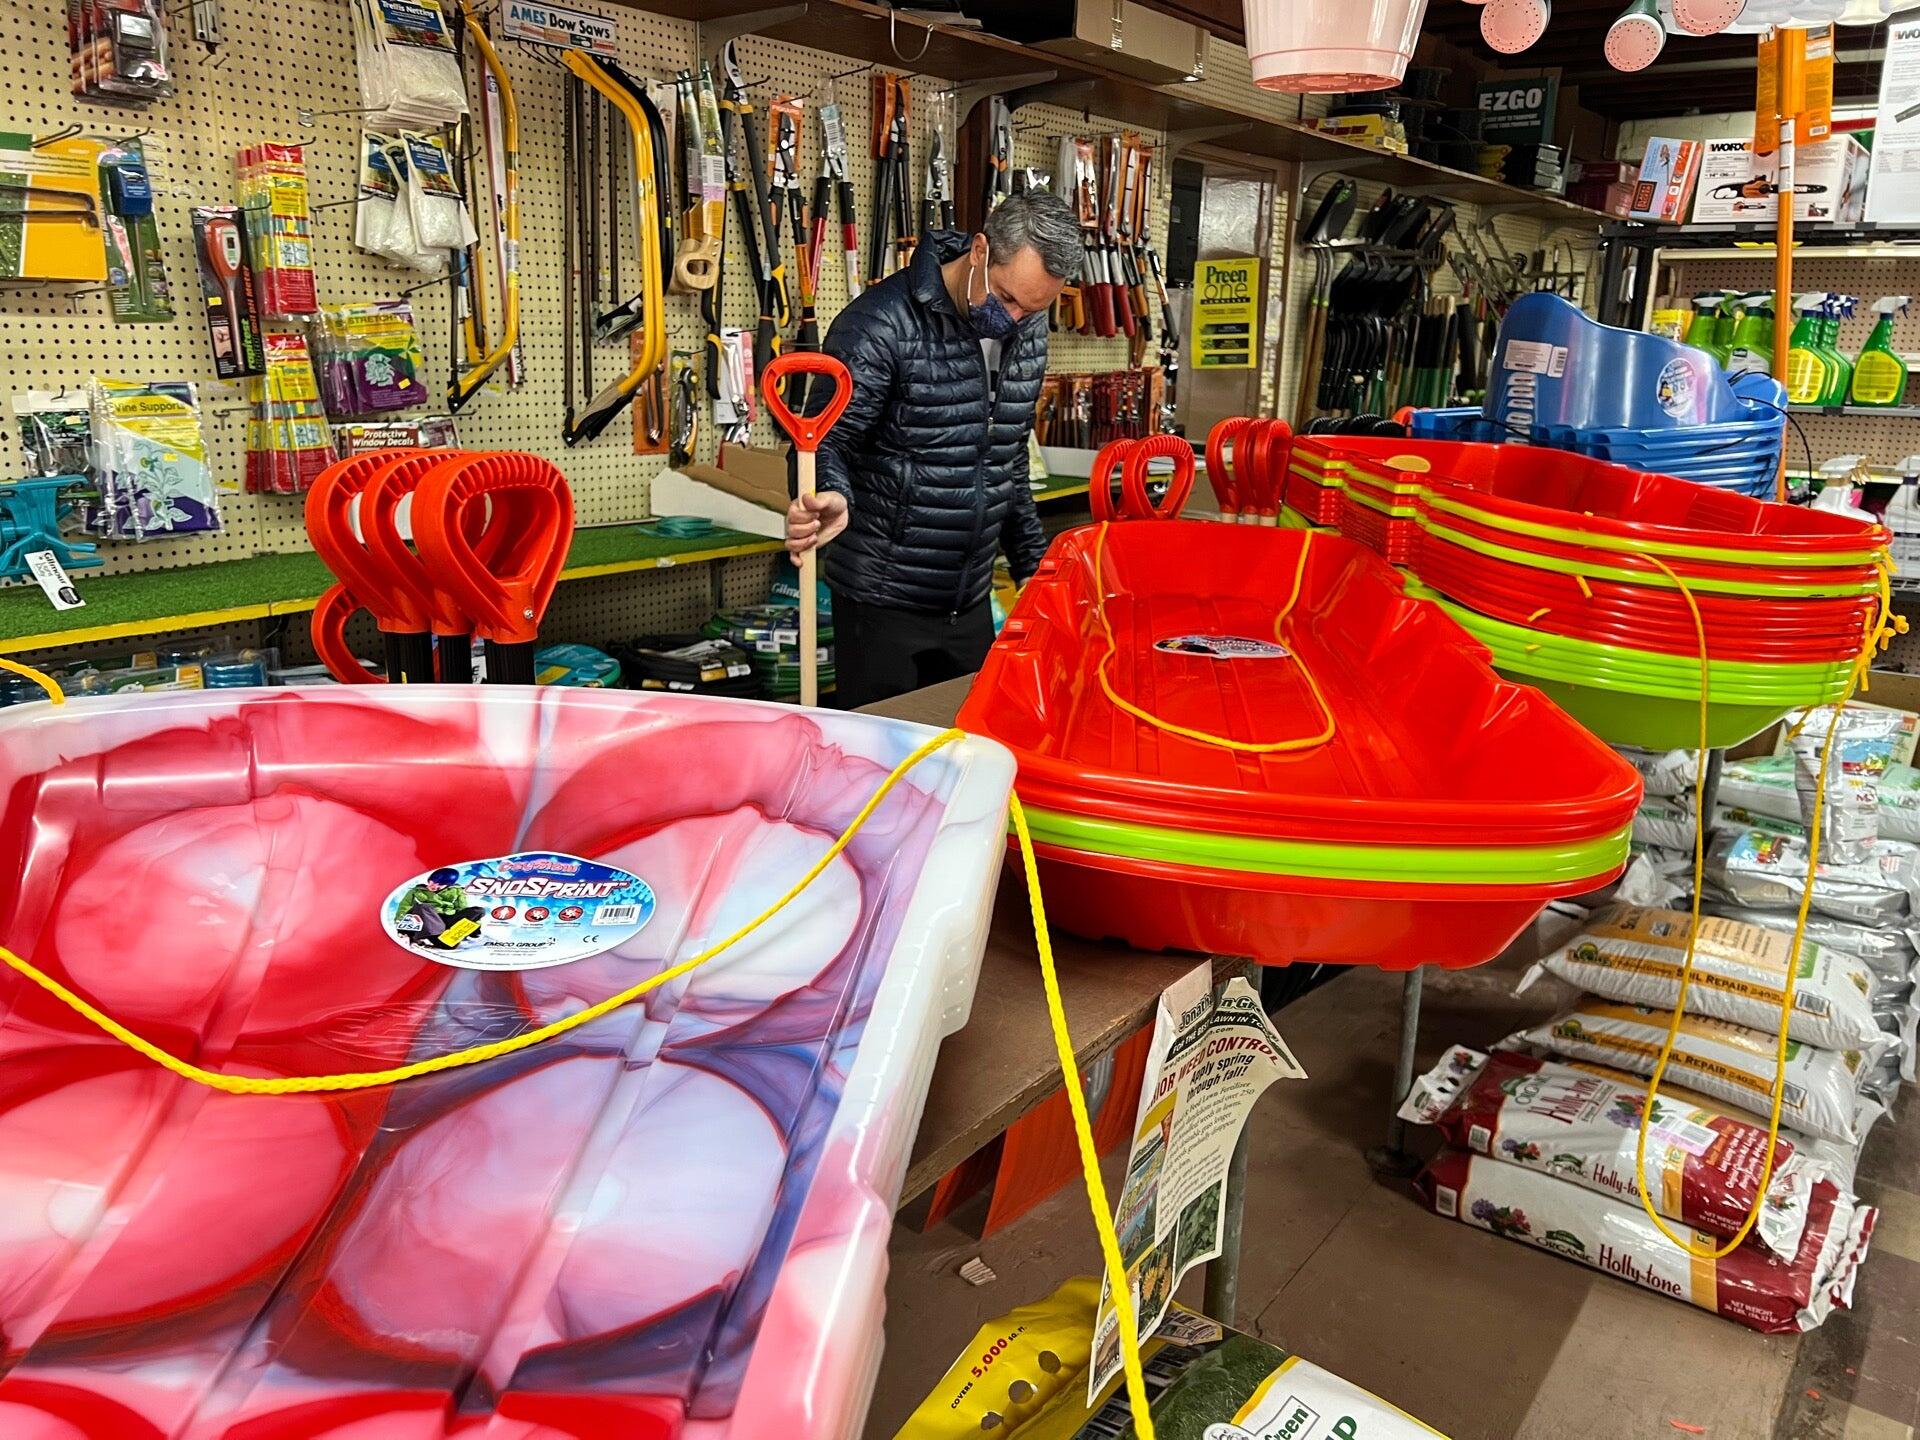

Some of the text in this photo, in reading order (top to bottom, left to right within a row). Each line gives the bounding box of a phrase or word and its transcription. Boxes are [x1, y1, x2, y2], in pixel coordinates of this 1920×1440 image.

[509, 5, 547, 26] AMES
[579, 20, 611, 39] Saws
[1897, 28, 1920, 40] WO
[1478, 87, 1543, 111] EZGO
[1710, 142, 1746, 152] WORX
[1205, 266, 1248, 284] Preen
[1203, 282, 1248, 300] one
[114, 403, 138, 412] Vine
[352, 437, 414, 447] Window Decals
[363, 429, 408, 439] Protective
[44, 552, 67, 584] Gilmour
[771, 582, 800, 599] Gilmo
[397, 922, 422, 932] USA
[483, 940, 548, 949] EMSCO GROUP
[1676, 967, 1702, 983] SIL
[1705, 975, 1749, 993] REPAIR
[1172, 1039, 1185, 1055] FOR
[1210, 1013, 1236, 1024] LAWN
[1237, 1015, 1250, 1023] IN
[1205, 1036, 1279, 1066] CONTROL
[1190, 1053, 1256, 1086] Apply spring
[1685, 1055, 1728, 1075] REPAIR
[1186, 1066, 1248, 1103] through fall!
[1592, 1162, 1653, 1198] Holly-toe
[1535, 1236, 1682, 1297] ORGANIC Holly-tone
[950, 1380, 974, 1410] COVERS
[970, 1337, 1009, 1379] 5,000
